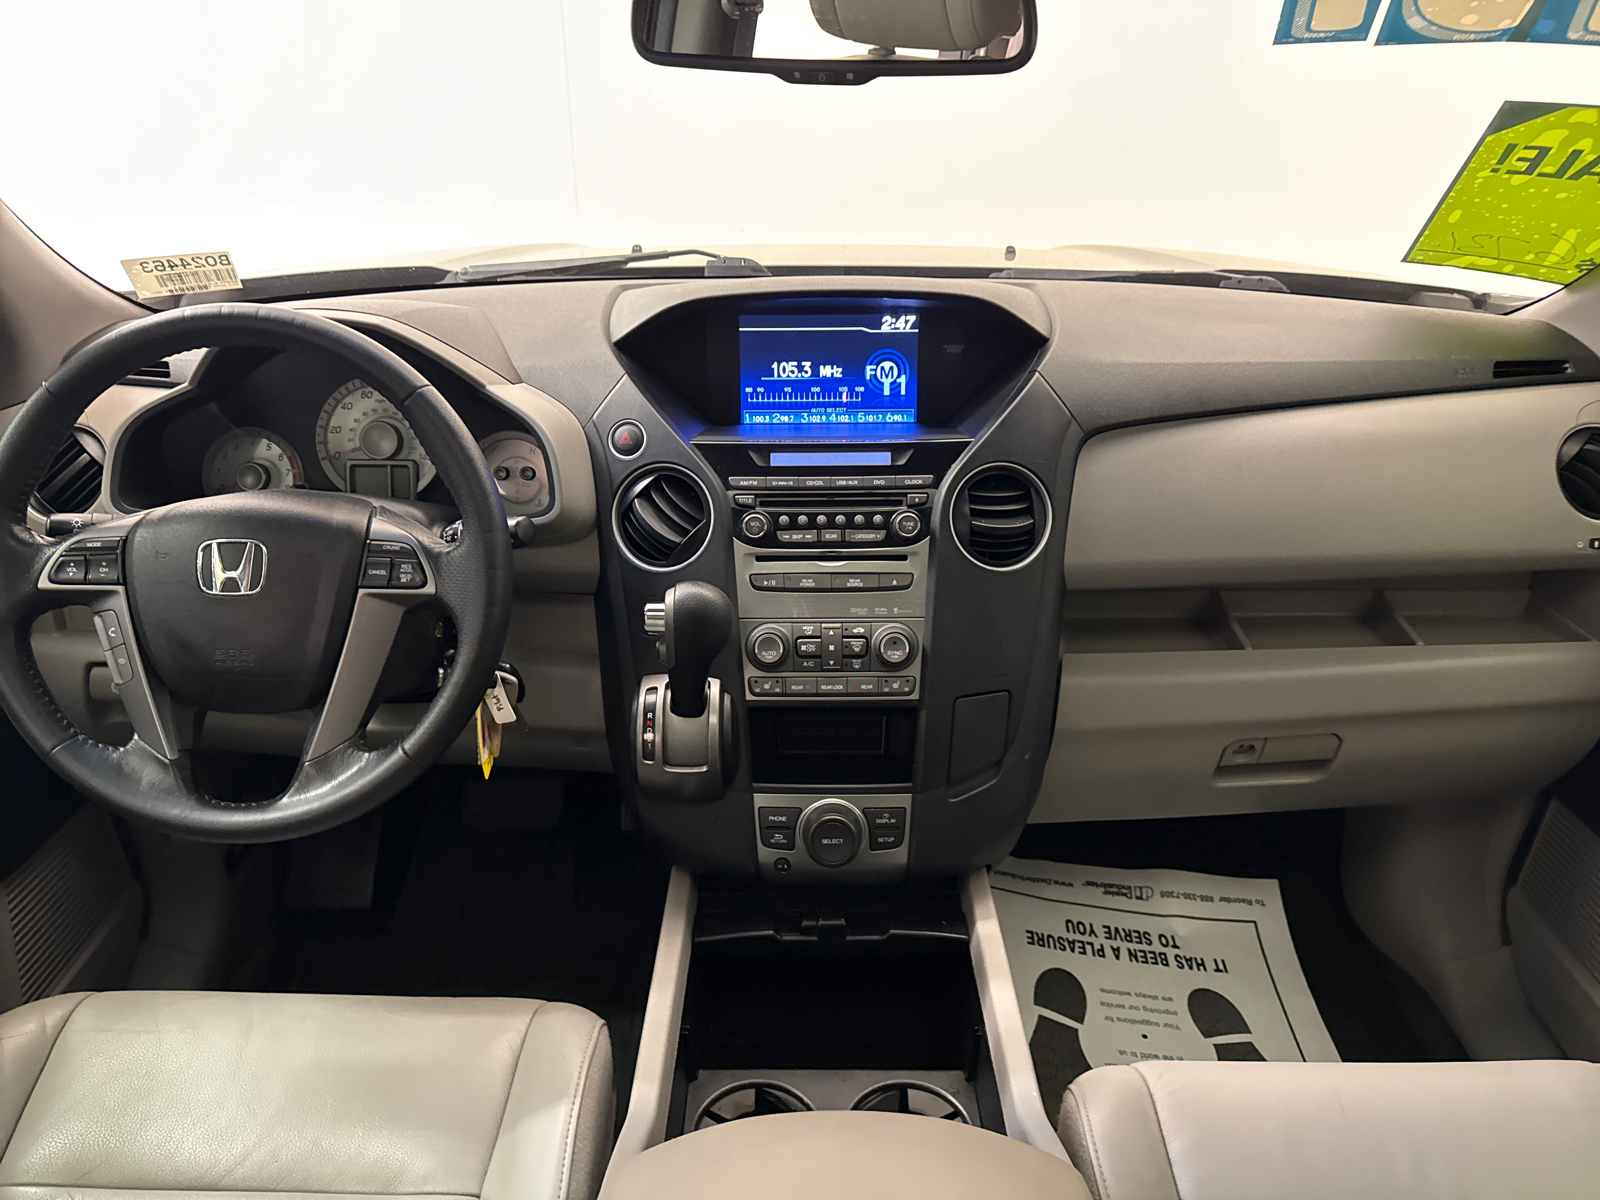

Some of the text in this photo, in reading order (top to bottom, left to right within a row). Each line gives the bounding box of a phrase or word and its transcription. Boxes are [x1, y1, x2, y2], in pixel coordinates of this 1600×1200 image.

[881, 315, 917, 331] 2:47
[771, 361, 843, 378] 105.3 MHz
[360, 390, 374, 399] 60
[340, 402, 353, 410] 40
[745, 413, 750, 423] 1
[772, 413, 780, 424] 2
[800, 413, 809, 423] 3
[829, 413, 837, 423] 4
[857, 412, 866, 423] 5
[886, 412, 894, 423] 6
[330, 426, 342, 434] 20
[266, 443, 272, 451] 5
[529, 447, 536, 455] H
[278, 453, 284, 462] 6
[333, 451, 341, 460] 0
[285, 469, 292, 477] 7
[1219, 895, 1253, 906] Reorder
[1255, 898, 1266, 907] To
[1065, 918, 1181, 950] TO SERVE YOU
[1025, 929, 1229, 974] IT HAS BEEN A PLEASURE
[1134, 991, 1159, 1001] always
[1100, 1001, 1179, 1017] improving our service
[1104, 1015, 1181, 1031] Your suggestions for
[1116, 1048, 1128, 1057] us.
[1130, 1050, 1138, 1058] to
[1140, 1051, 1161, 1060] world
